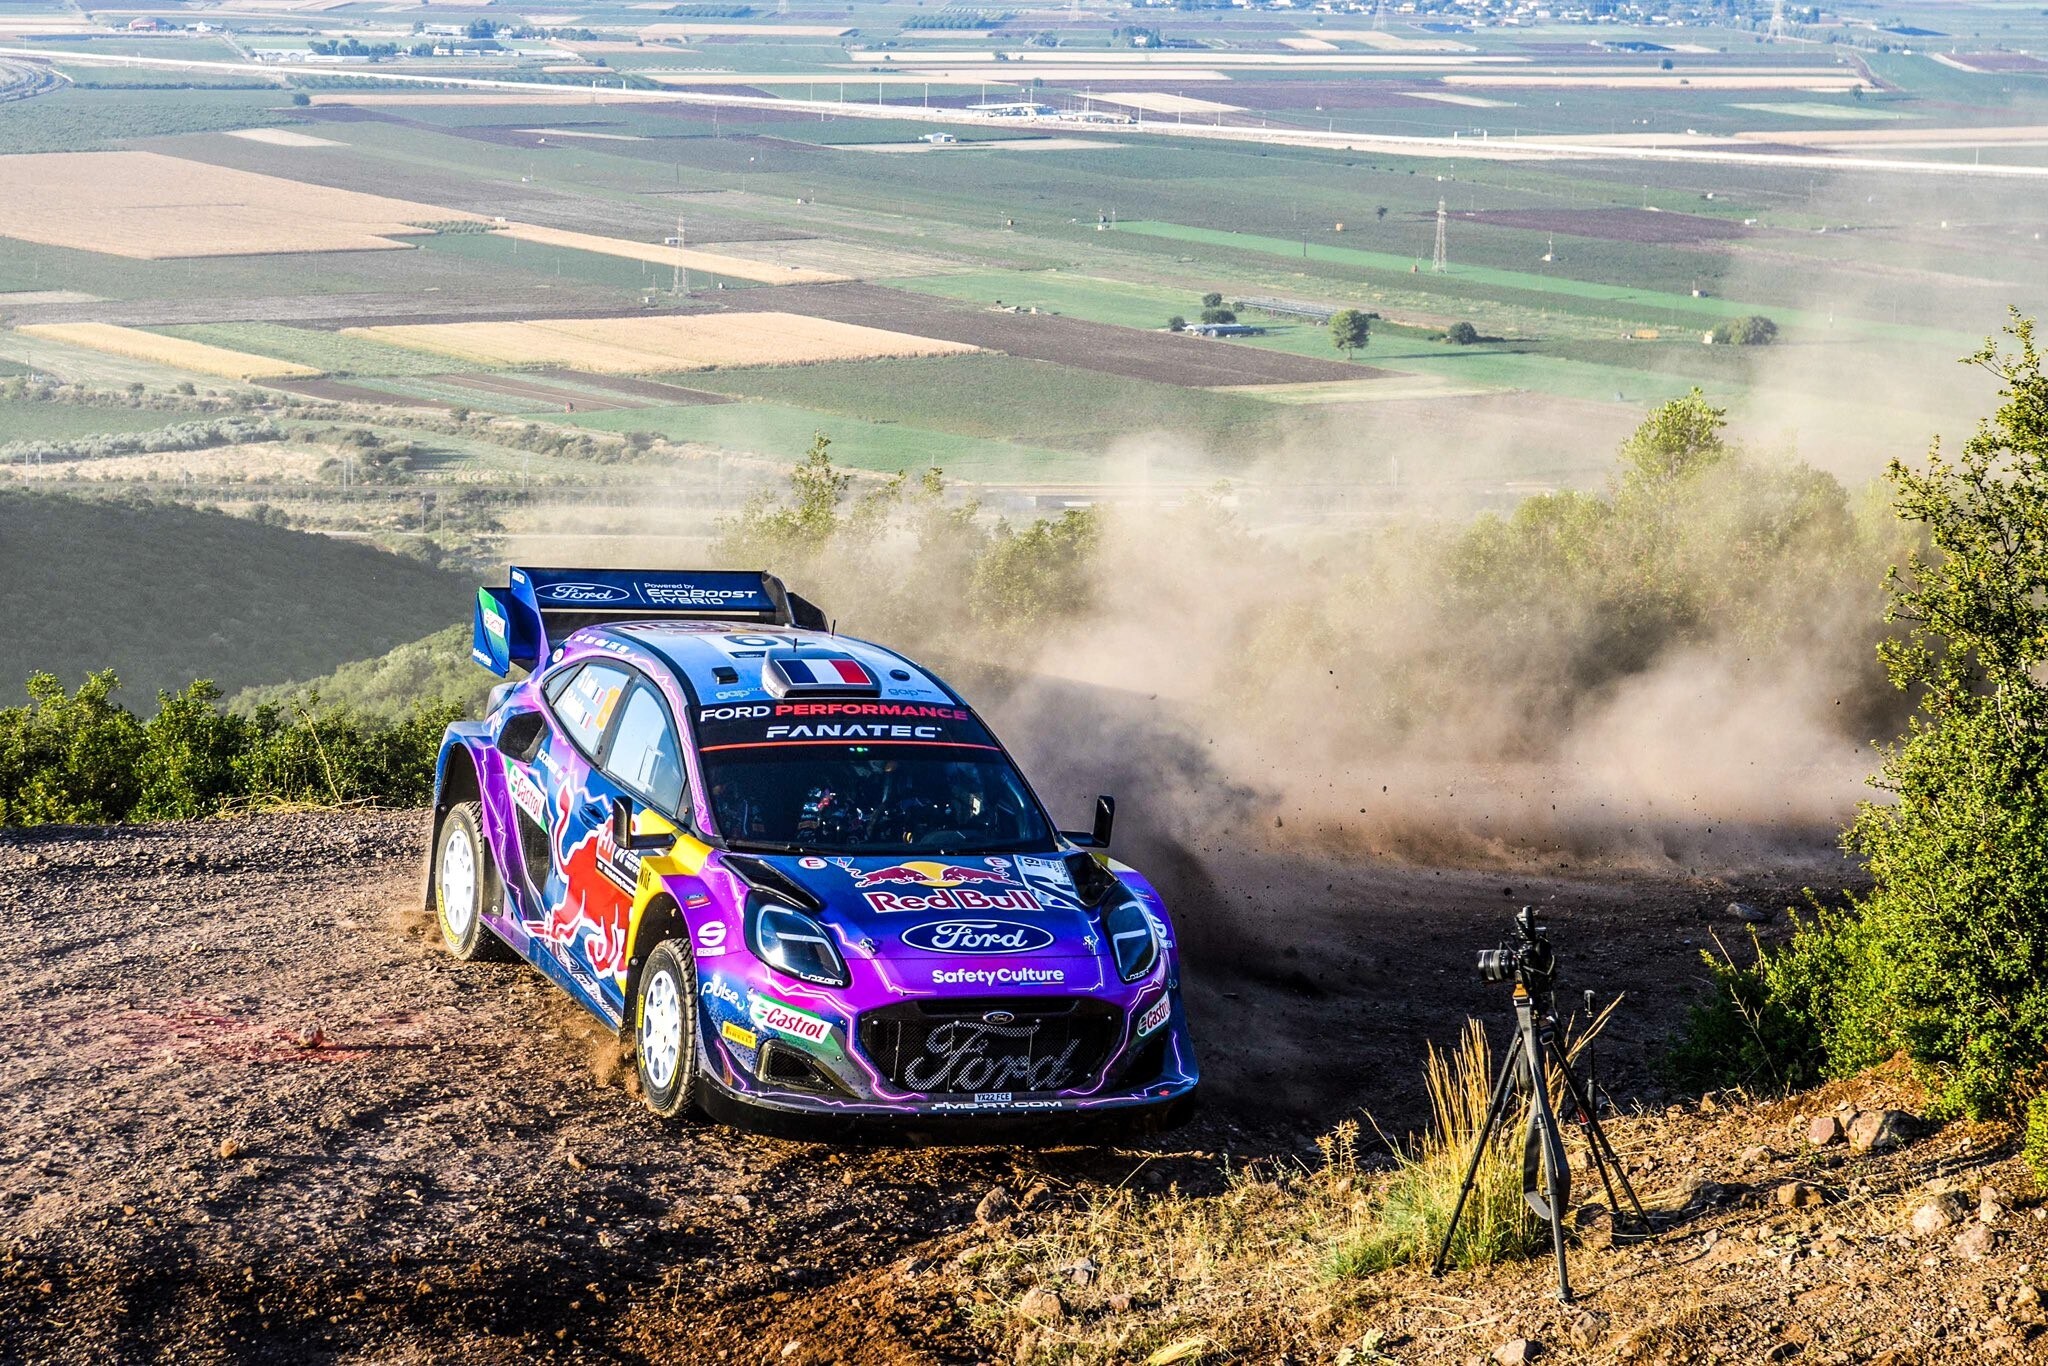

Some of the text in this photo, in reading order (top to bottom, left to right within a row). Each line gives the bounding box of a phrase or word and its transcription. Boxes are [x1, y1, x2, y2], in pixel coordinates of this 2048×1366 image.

[552, 585, 613, 600] Ford
[651, 597, 724, 605] HYBRID
[700, 703, 968, 722] FORD PERFORMANCE
[766, 724, 936, 739] FANATEC
[517, 777, 542, 819] Castrol
[931, 922, 1028, 948] Ford
[931, 967, 1065, 987] SafetyCulture
[767, 1008, 825, 1039] Castrol
[904, 1021, 1081, 1091] Ford
[977, 1092, 1010, 1101] YX22 FCE
